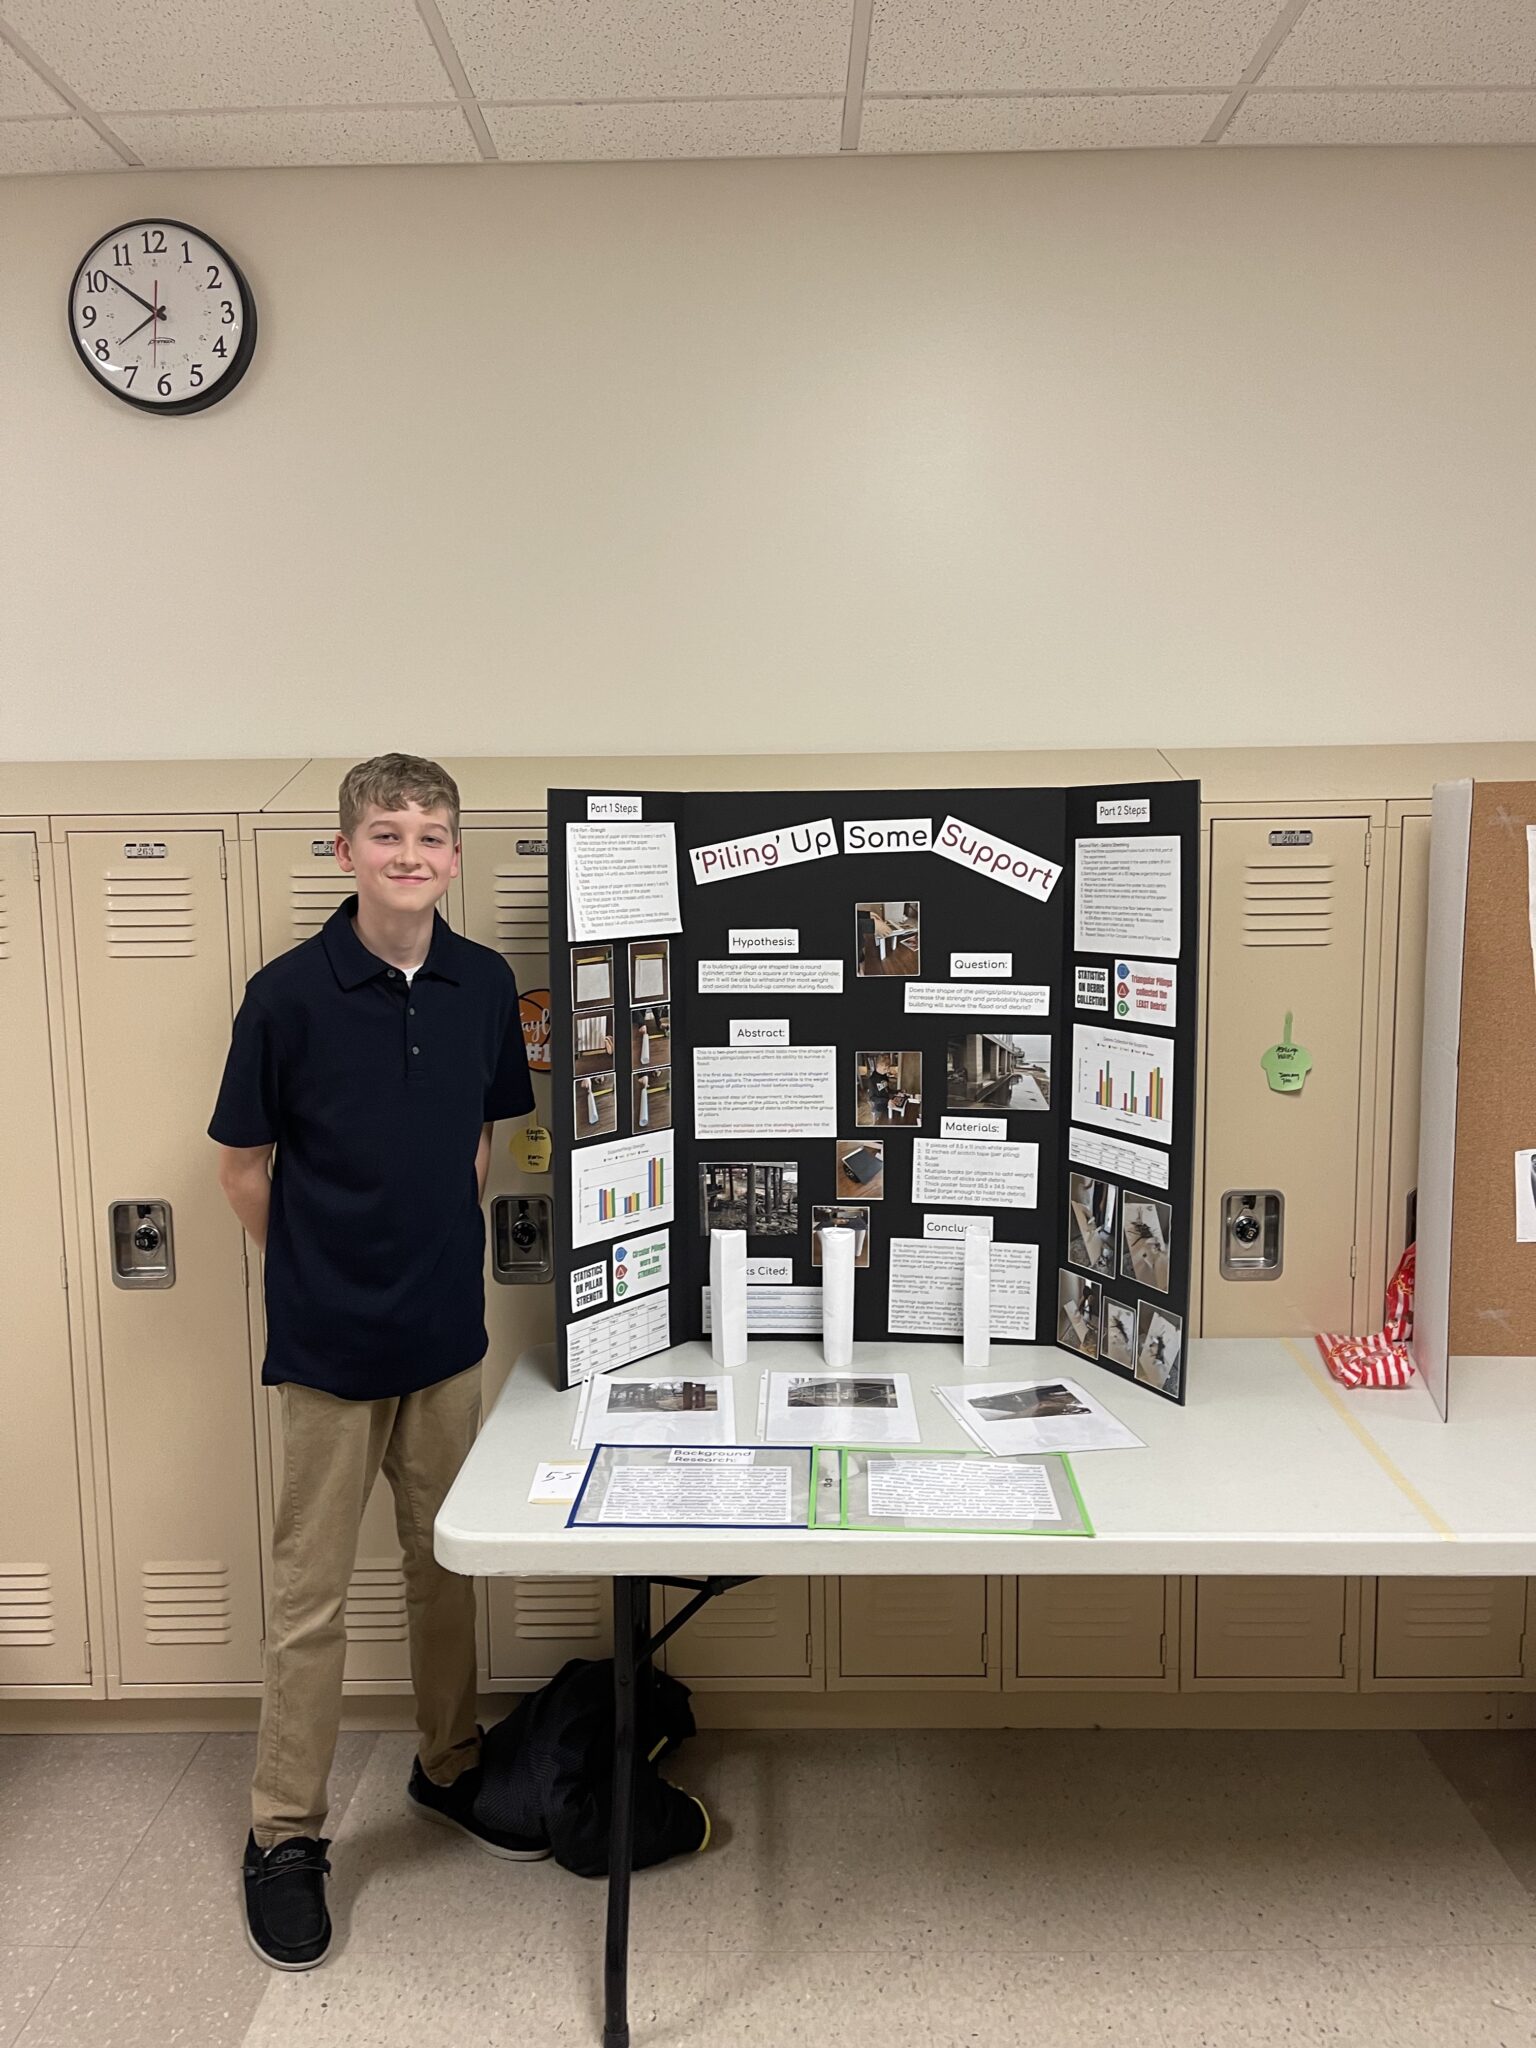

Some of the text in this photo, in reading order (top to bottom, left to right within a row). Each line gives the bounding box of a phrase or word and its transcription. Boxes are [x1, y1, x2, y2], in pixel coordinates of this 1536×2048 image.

[141, 230, 167, 254] 12
[112, 243, 132, 266] 11
[181, 241, 192, 263] 1
[85, 270, 108, 293] 10
[207, 266, 222, 289] 2
[82, 306, 97, 328] 9
[220, 301, 234, 324] 3
[95, 339, 110, 361] 8
[212, 336, 228, 357] 4
[124, 366, 138, 388] 7
[190, 364, 203, 386] 5
[157, 373, 172, 396] 6
[591, 803, 638, 814] Part 1 Steps:
[1100, 805, 1146, 816] Part 2 Steps:
[137, 848, 154, 856] 263
[790, 828, 832, 855] Up
[849, 826, 927, 849] Some
[941, 824, 1053, 890] Support
[732, 937, 796, 948] Hypothesis:
[954, 960, 1008, 969] Question:
[1078, 970, 1105, 981] STATISTICS
[1079, 983, 1104, 993] ON DEBRIS
[1077, 995, 1106, 1006] COLLECTION
[737, 1028, 785, 1037] Abstract:
[946, 1122, 1000, 1133] Materials:
[573, 1265, 602, 1283] STATISTICS
[758, 1266, 788, 1276] Cited:
[576, 1277, 603, 1294] ON PILLAR
[576, 1290, 603, 1307] STRENGTH
